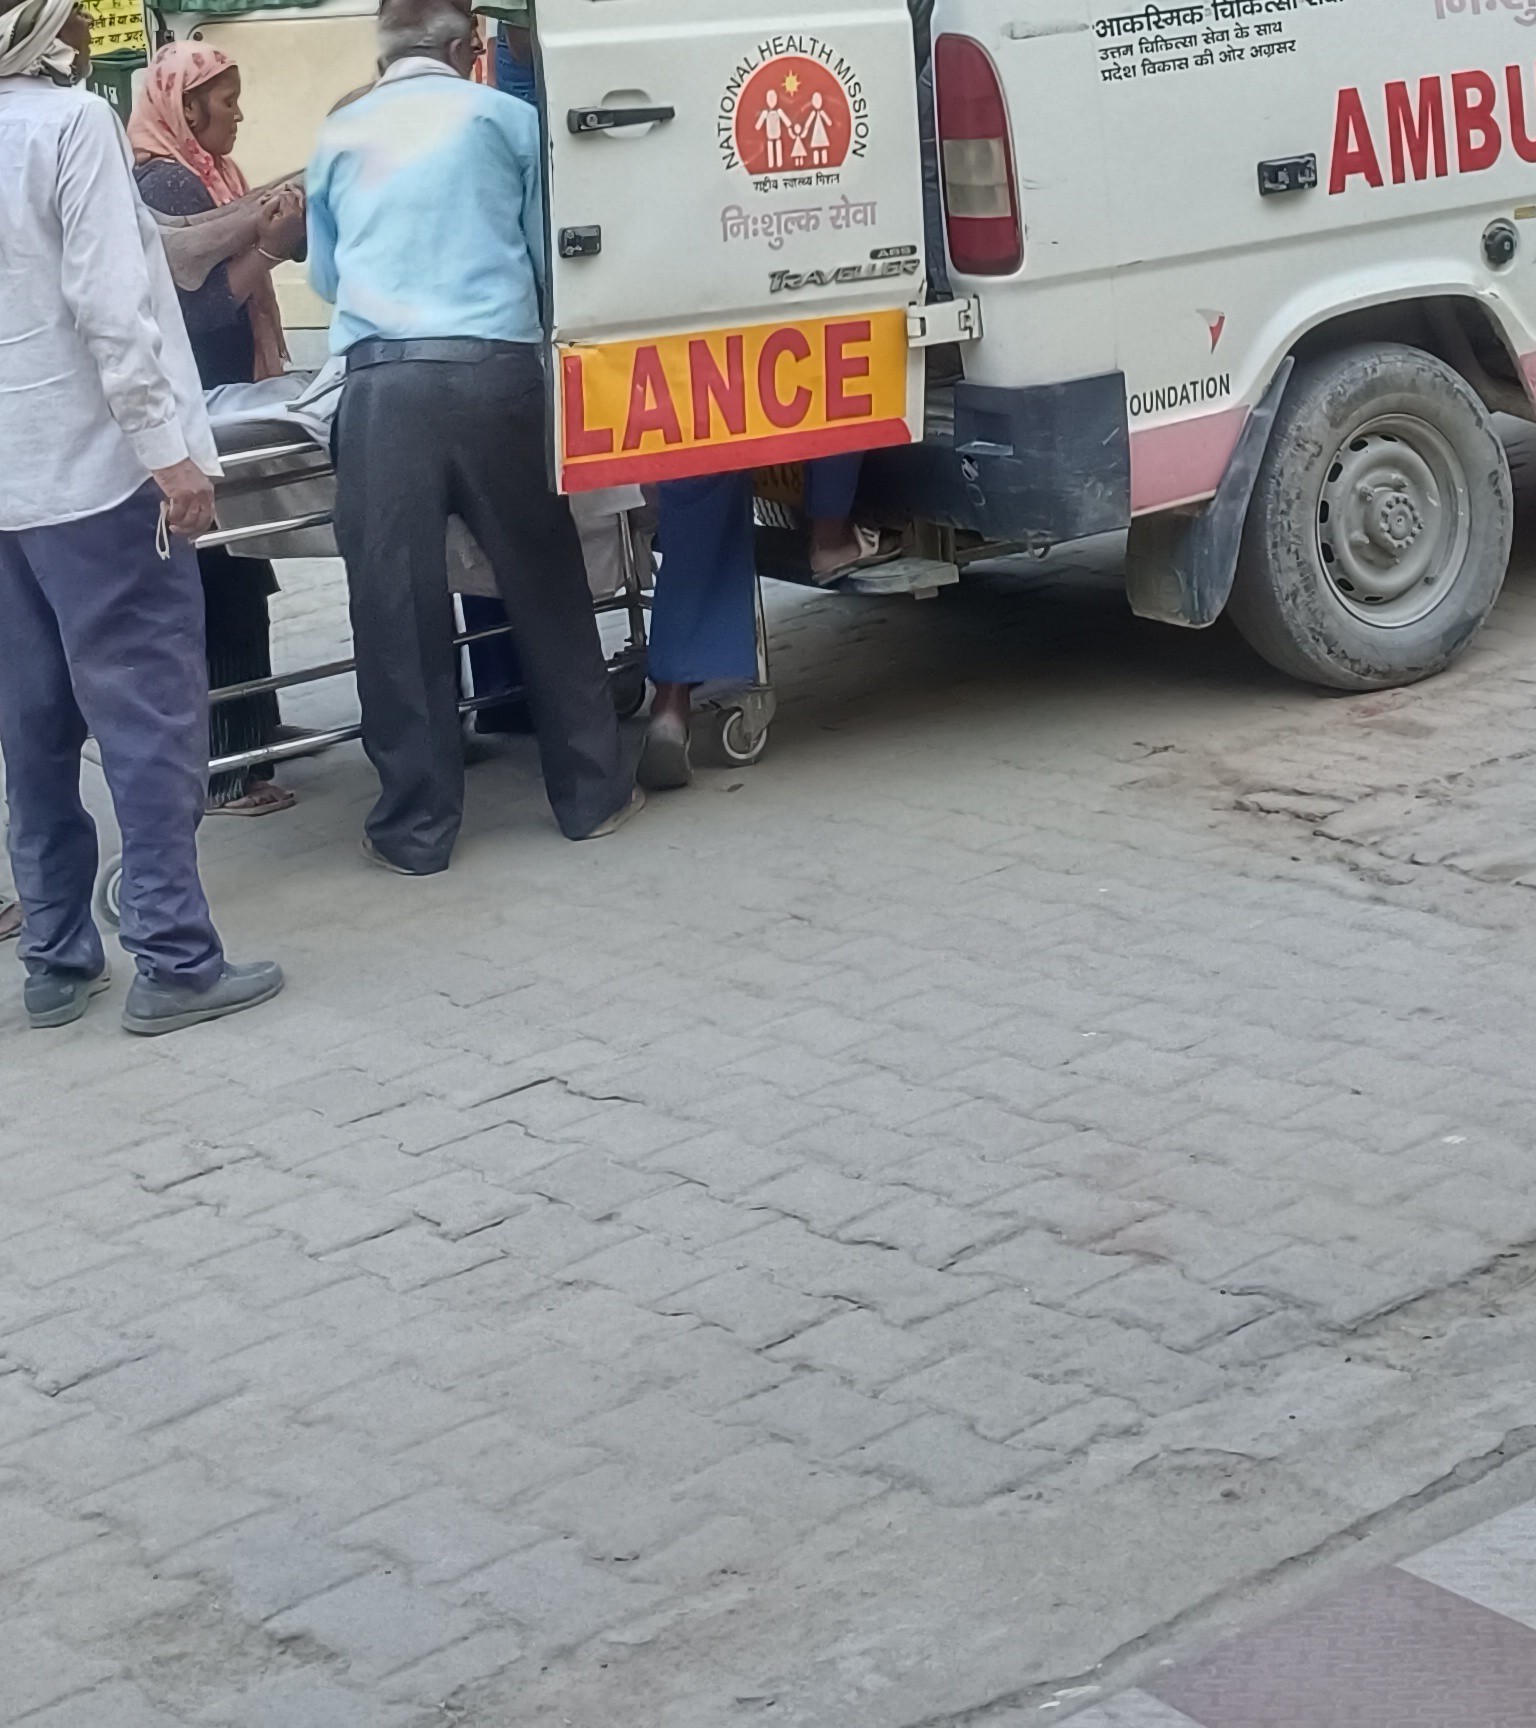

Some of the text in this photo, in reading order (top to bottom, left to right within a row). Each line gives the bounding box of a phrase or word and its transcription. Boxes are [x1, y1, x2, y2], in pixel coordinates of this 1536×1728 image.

[1095, 3, 1204, 40] आकस्मिक
[1098, 21, 1284, 62] उत्तम चिकित्सा सेवा के साथ
[1100, 39, 1297, 83] प्रदेश विकास की ओर अग्रसर
[717, 34, 871, 170] NATIONAL HEALTH MISSION
[829, 193, 878, 230] सेवा
[768, 258, 921, 295] TRAVELLER
[563, 320, 874, 458] LANCE
